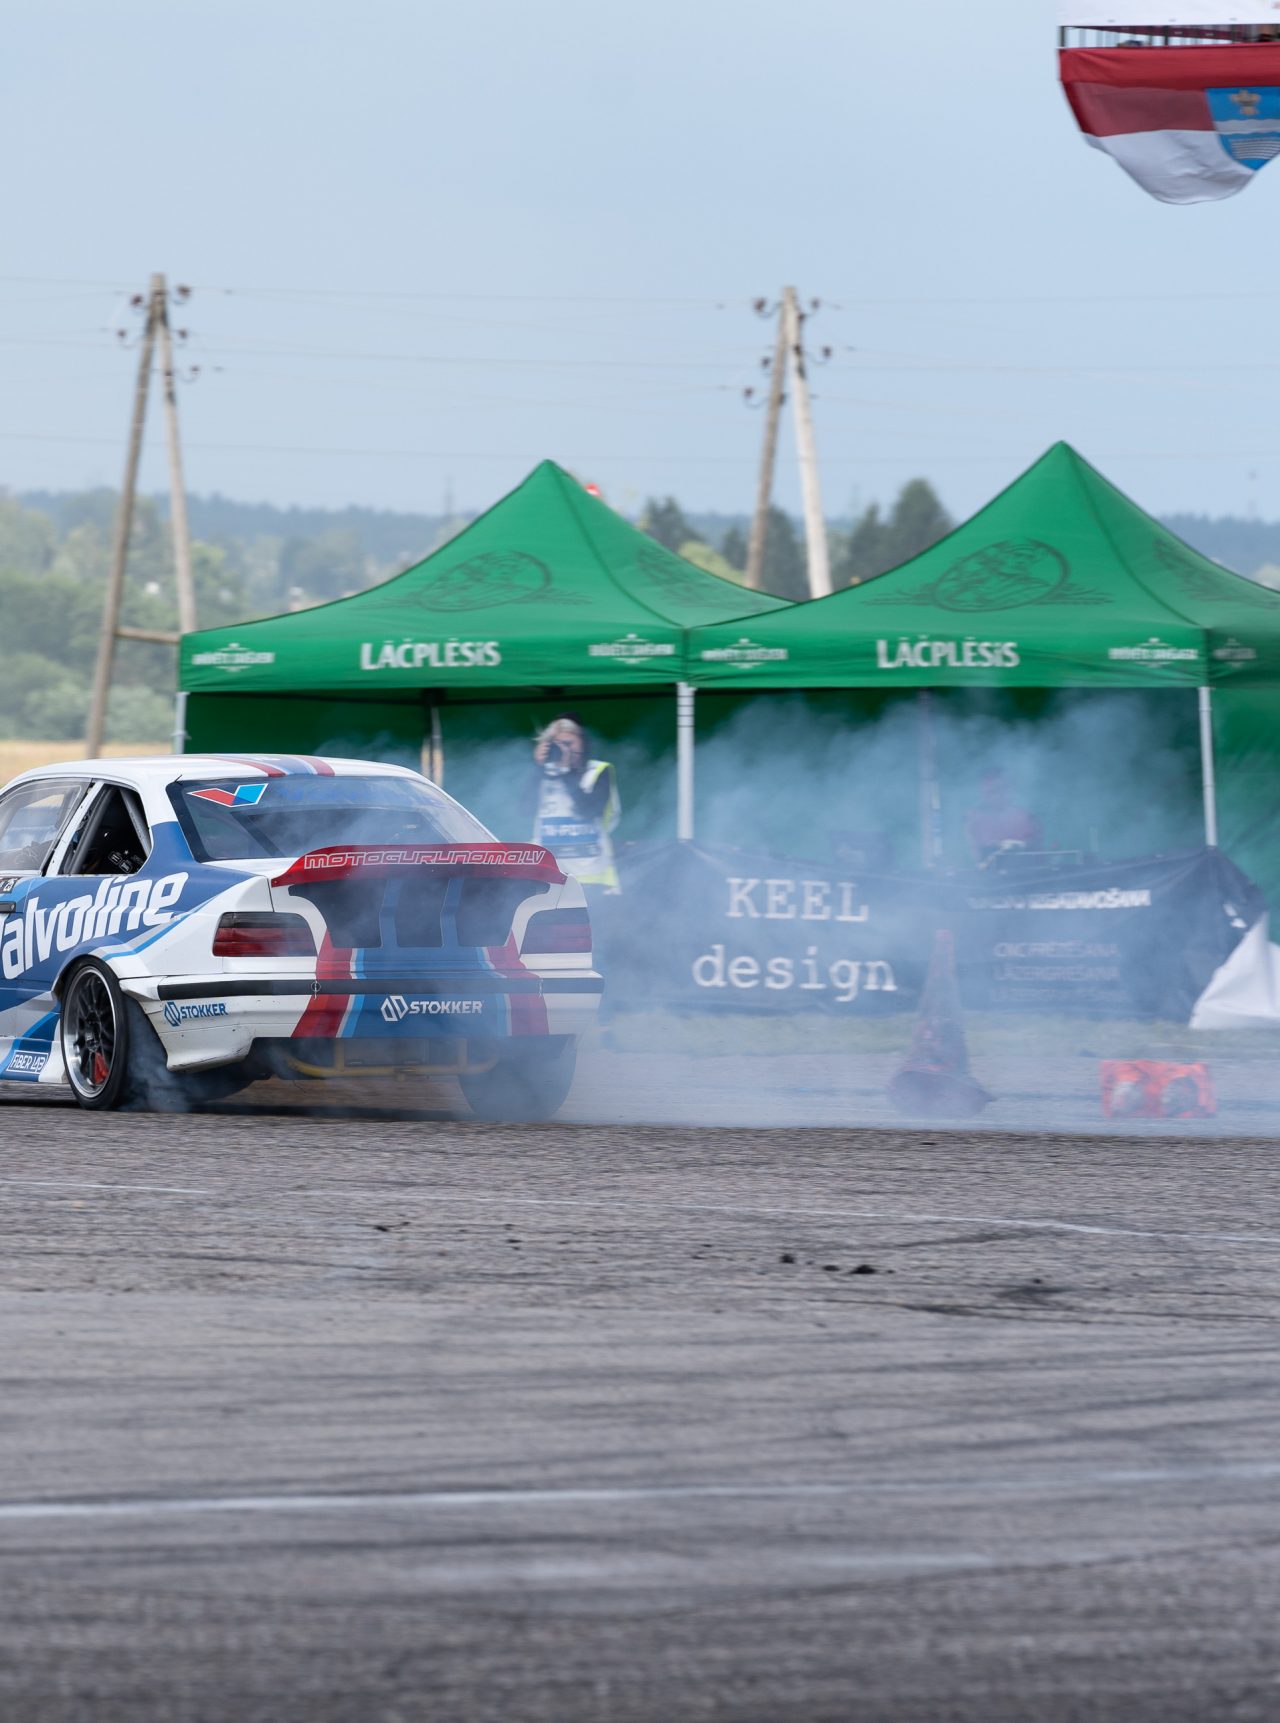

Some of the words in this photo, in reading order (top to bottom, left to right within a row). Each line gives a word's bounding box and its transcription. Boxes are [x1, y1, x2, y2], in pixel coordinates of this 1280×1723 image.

[725, 877, 870, 922] KEEL
[691, 944, 898, 1002] design
[180, 1003, 228, 1020] STOKKER
[409, 1000, 483, 1015] STOKKER
